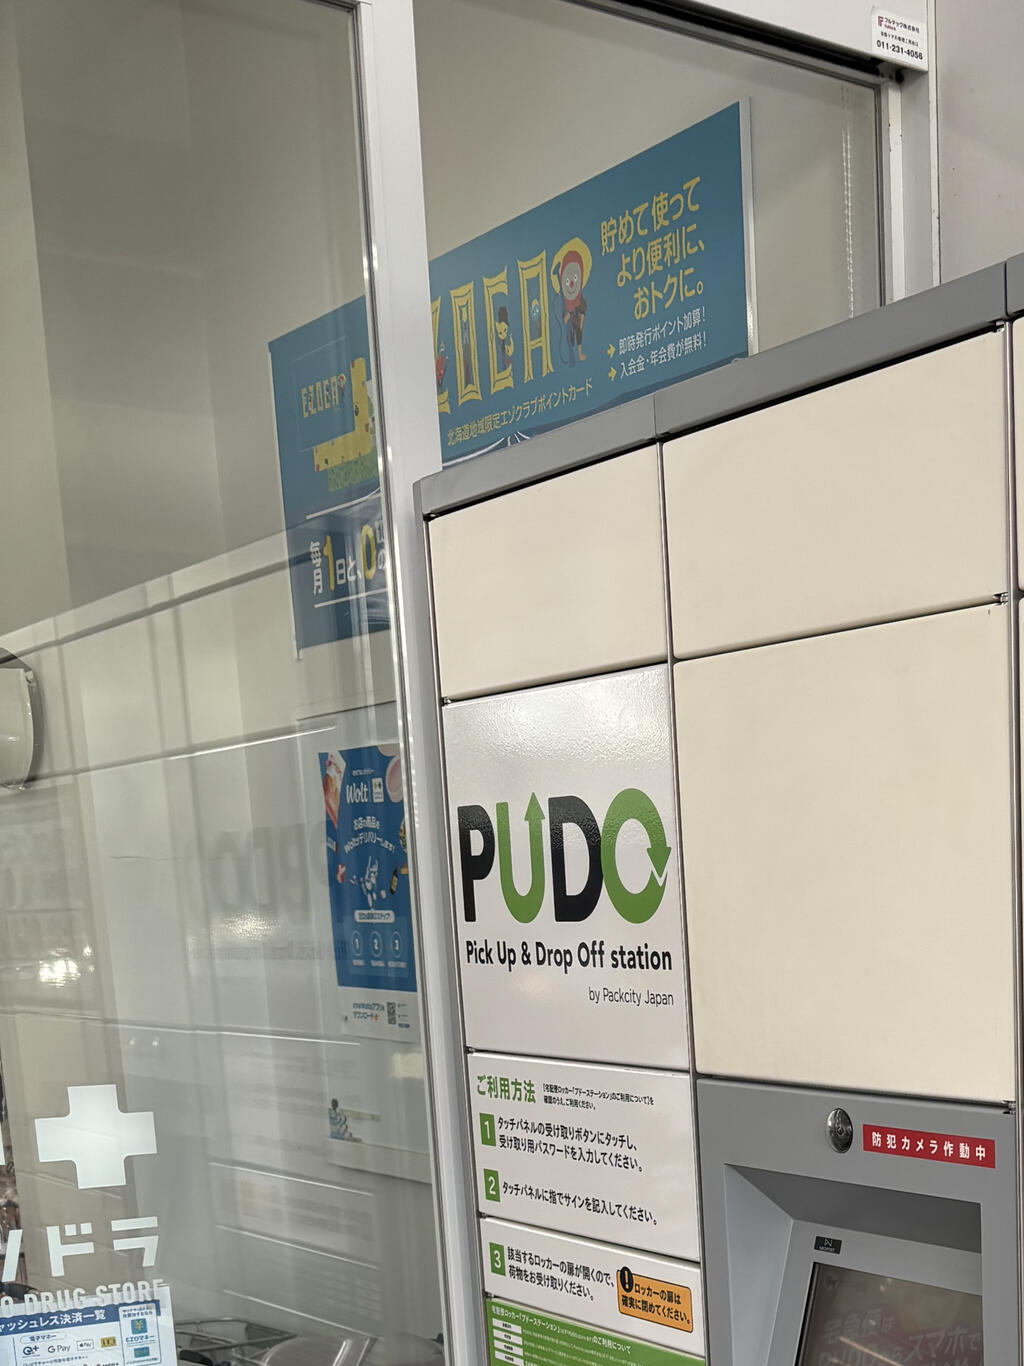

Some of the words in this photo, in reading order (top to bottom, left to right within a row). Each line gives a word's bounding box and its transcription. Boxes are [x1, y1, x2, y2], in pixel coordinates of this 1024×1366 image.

[600, 177, 701, 256] 貯めて使って
[616, 223, 705, 287] より便利に、
[634, 267, 704, 320] おトクに。
[457, 787, 672, 924] PUDO
[466, 939, 493, 965] Pick
[496, 940, 517, 973] Up
[521, 942, 532, 965] &
[535, 941, 573, 975] Drop
[577, 940, 605, 968] Off
[611, 943, 672, 970] station
[588, 986, 601, 1004] by
[602, 987, 641, 1007] Packcity
[644, 989, 674, 1008] Japan
[476, 1075, 536, 1103] ご利用方法
[872, 1131, 986, 1161] 防犯カメラ作動中
[488, 1176, 496, 1195] 2
[494, 1250, 502, 1268] 3
